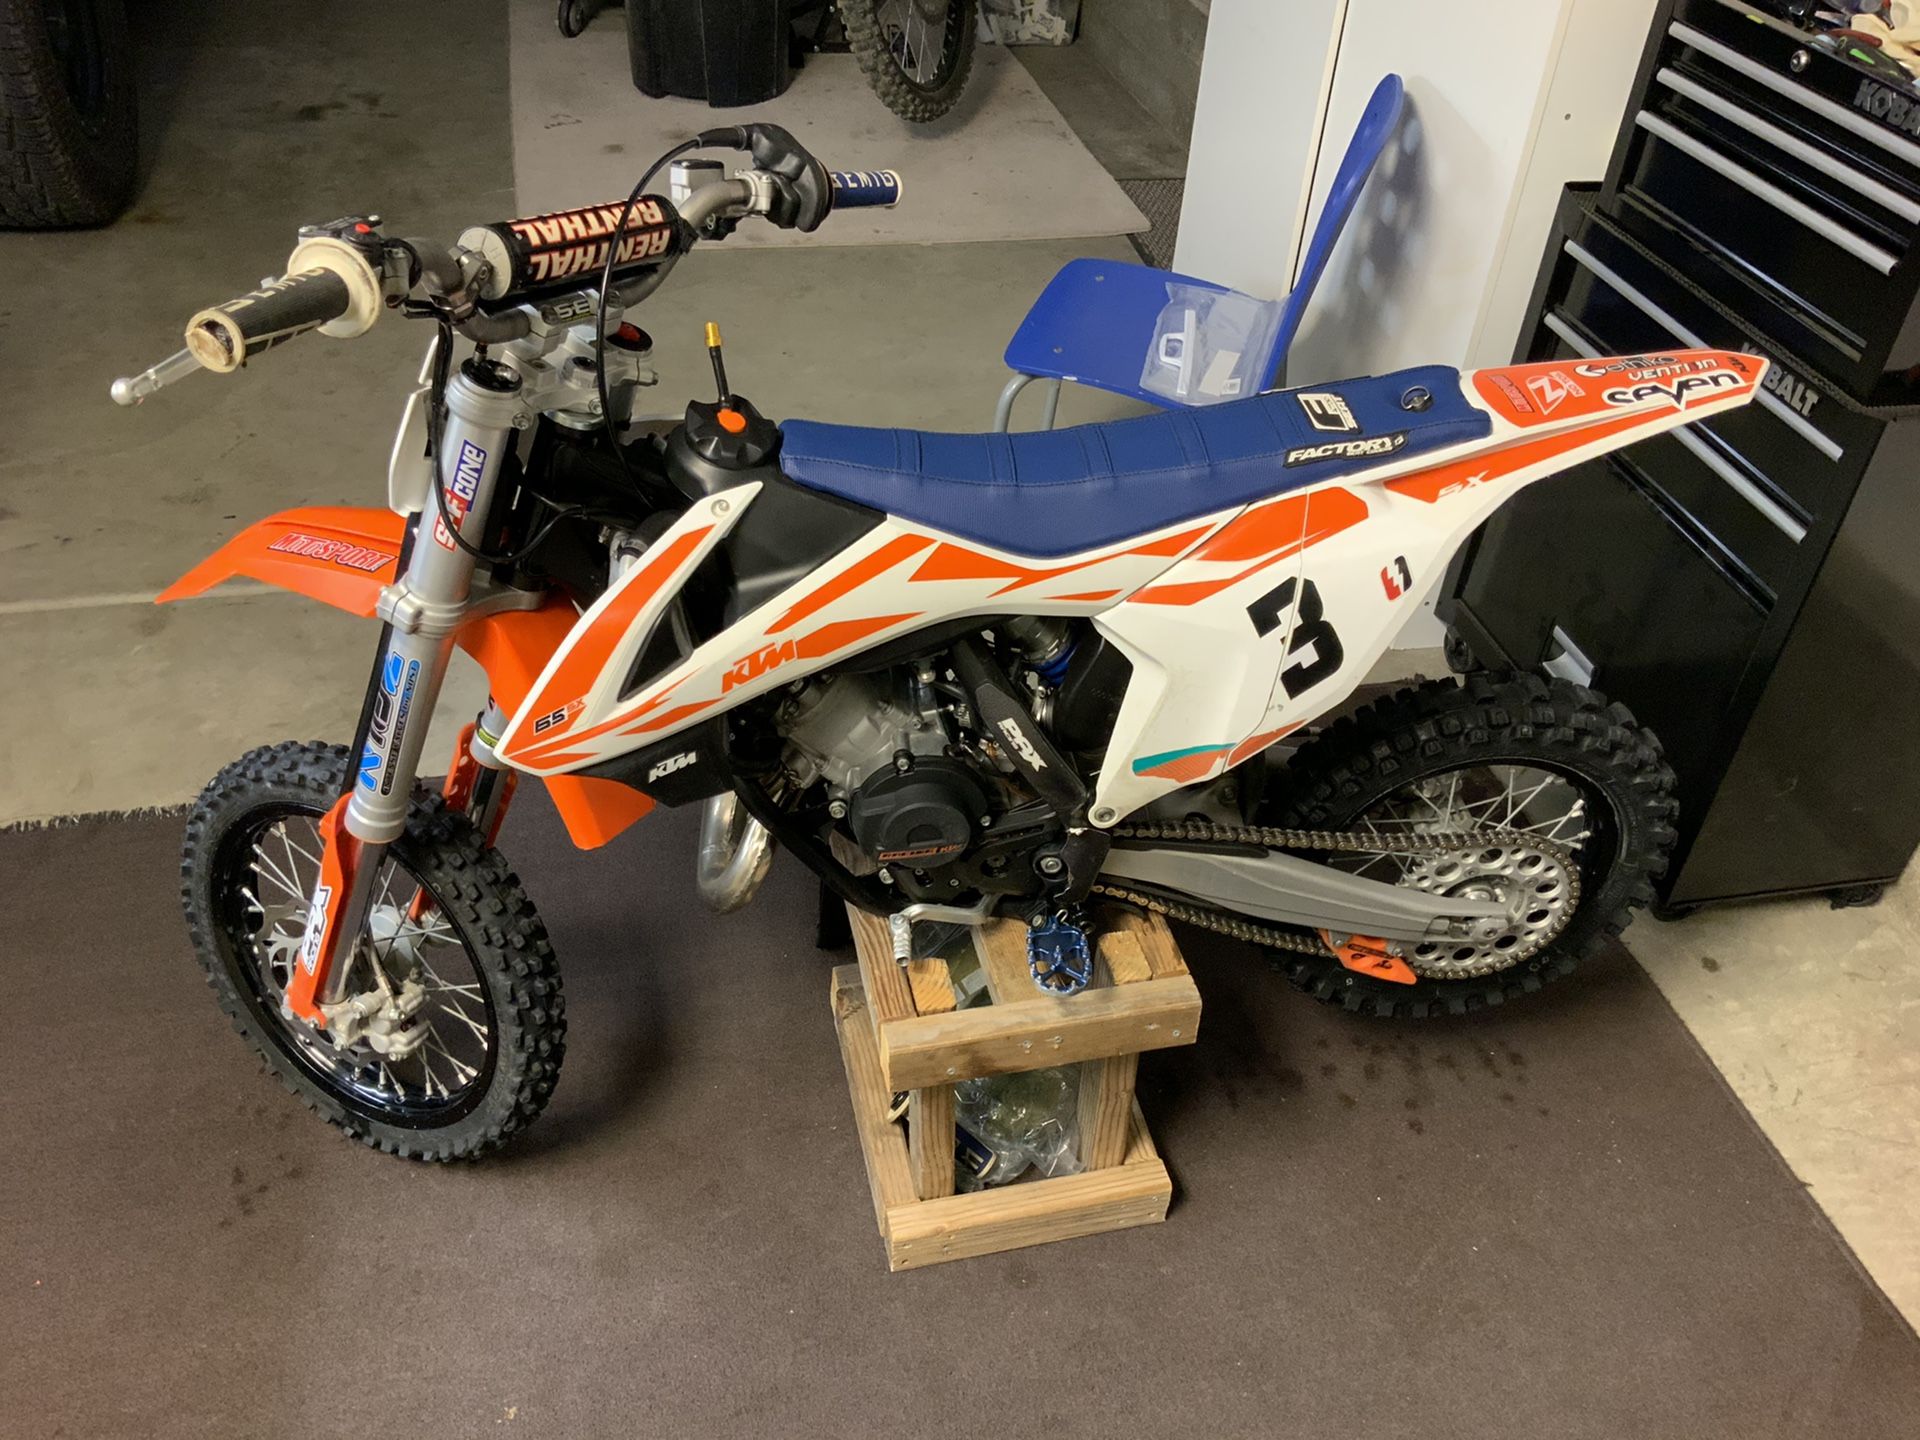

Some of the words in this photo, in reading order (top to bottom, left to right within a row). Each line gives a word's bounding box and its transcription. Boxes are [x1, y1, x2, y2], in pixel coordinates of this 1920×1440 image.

[511, 199, 663, 246] RENTHAL
[530, 228, 671, 281] RENTHAL
[1741, 342, 1819, 415] BALT
[1246, 576, 1344, 700] 3
[721, 640, 796, 694] KTM
[534, 706, 567, 735] 65
[647, 748, 698, 784] KTM
